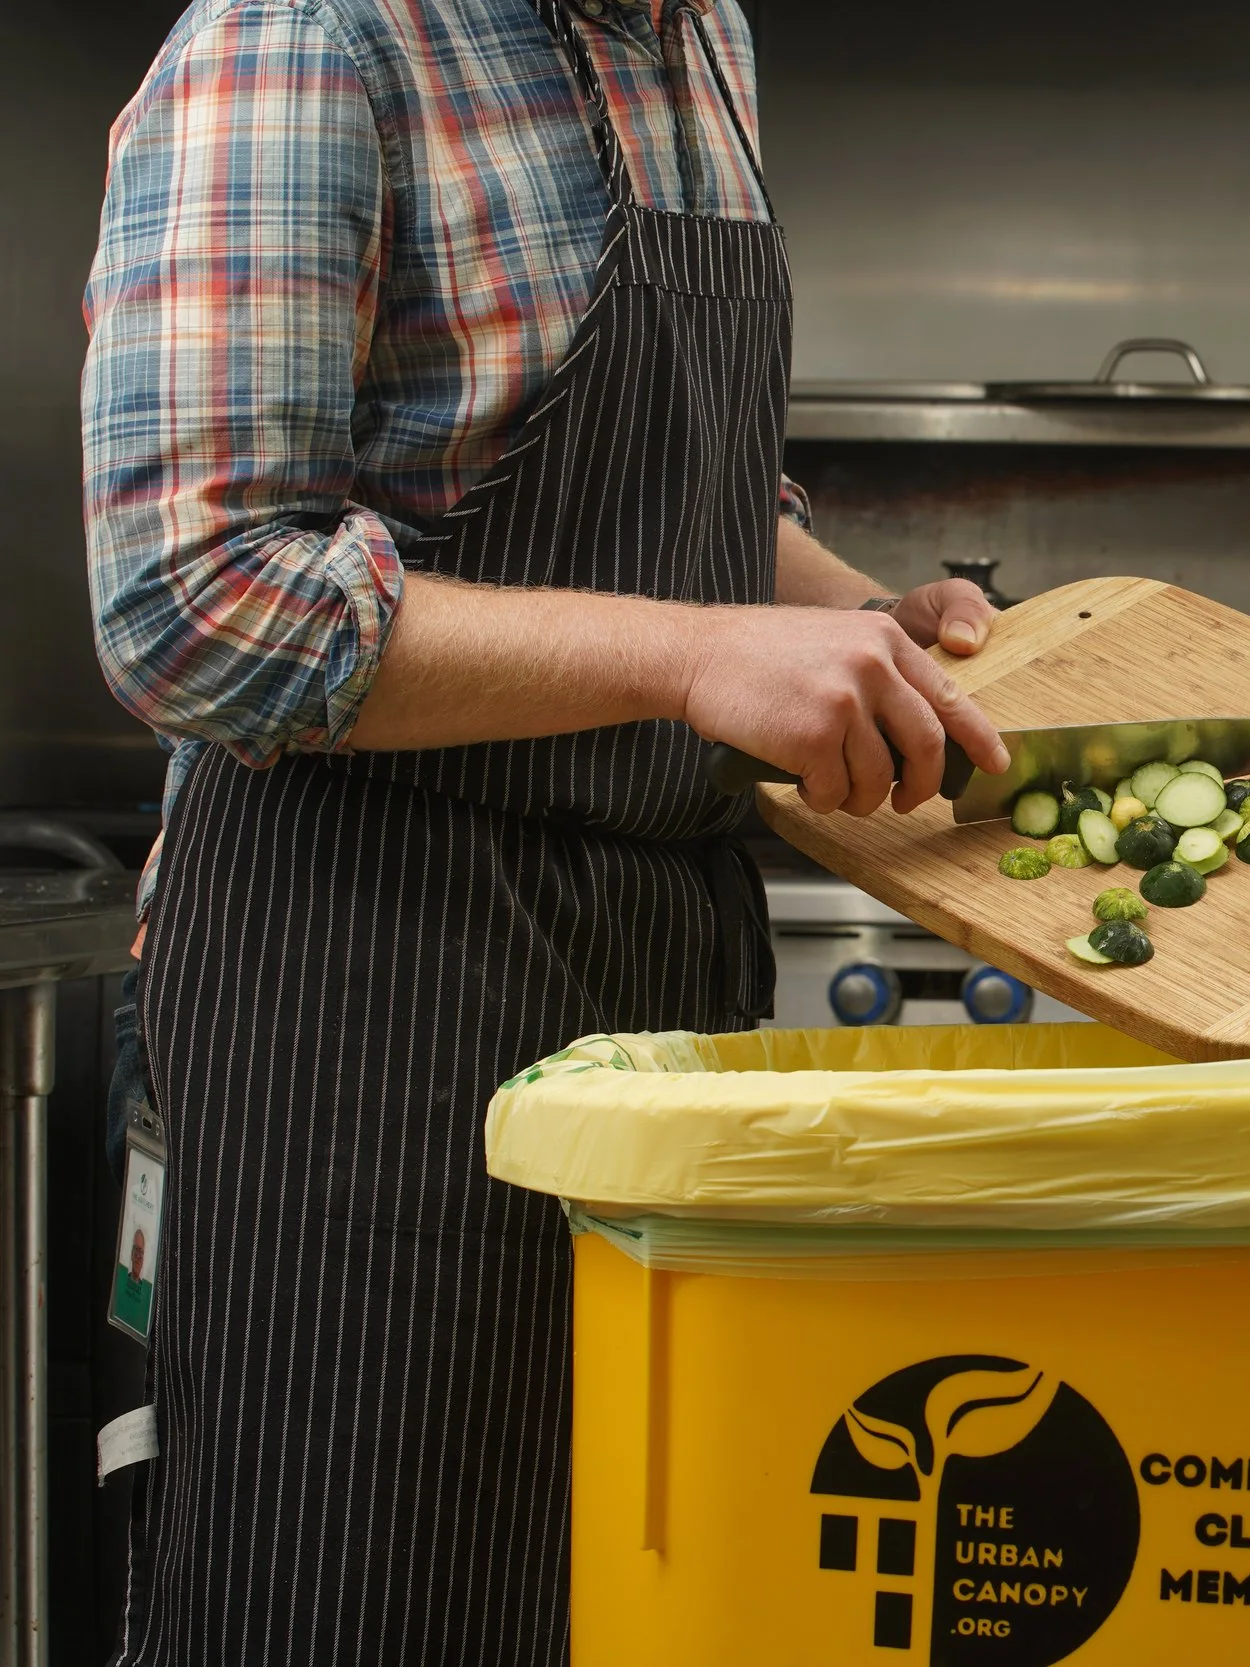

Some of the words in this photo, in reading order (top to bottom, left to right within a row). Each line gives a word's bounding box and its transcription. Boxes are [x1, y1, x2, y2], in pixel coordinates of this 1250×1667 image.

[957, 1503, 1015, 1529] THE
[955, 1540, 1064, 1569] URBAN
[952, 1578, 1090, 1608] CANOPY
[950, 1617, 1011, 1638] .ORG
